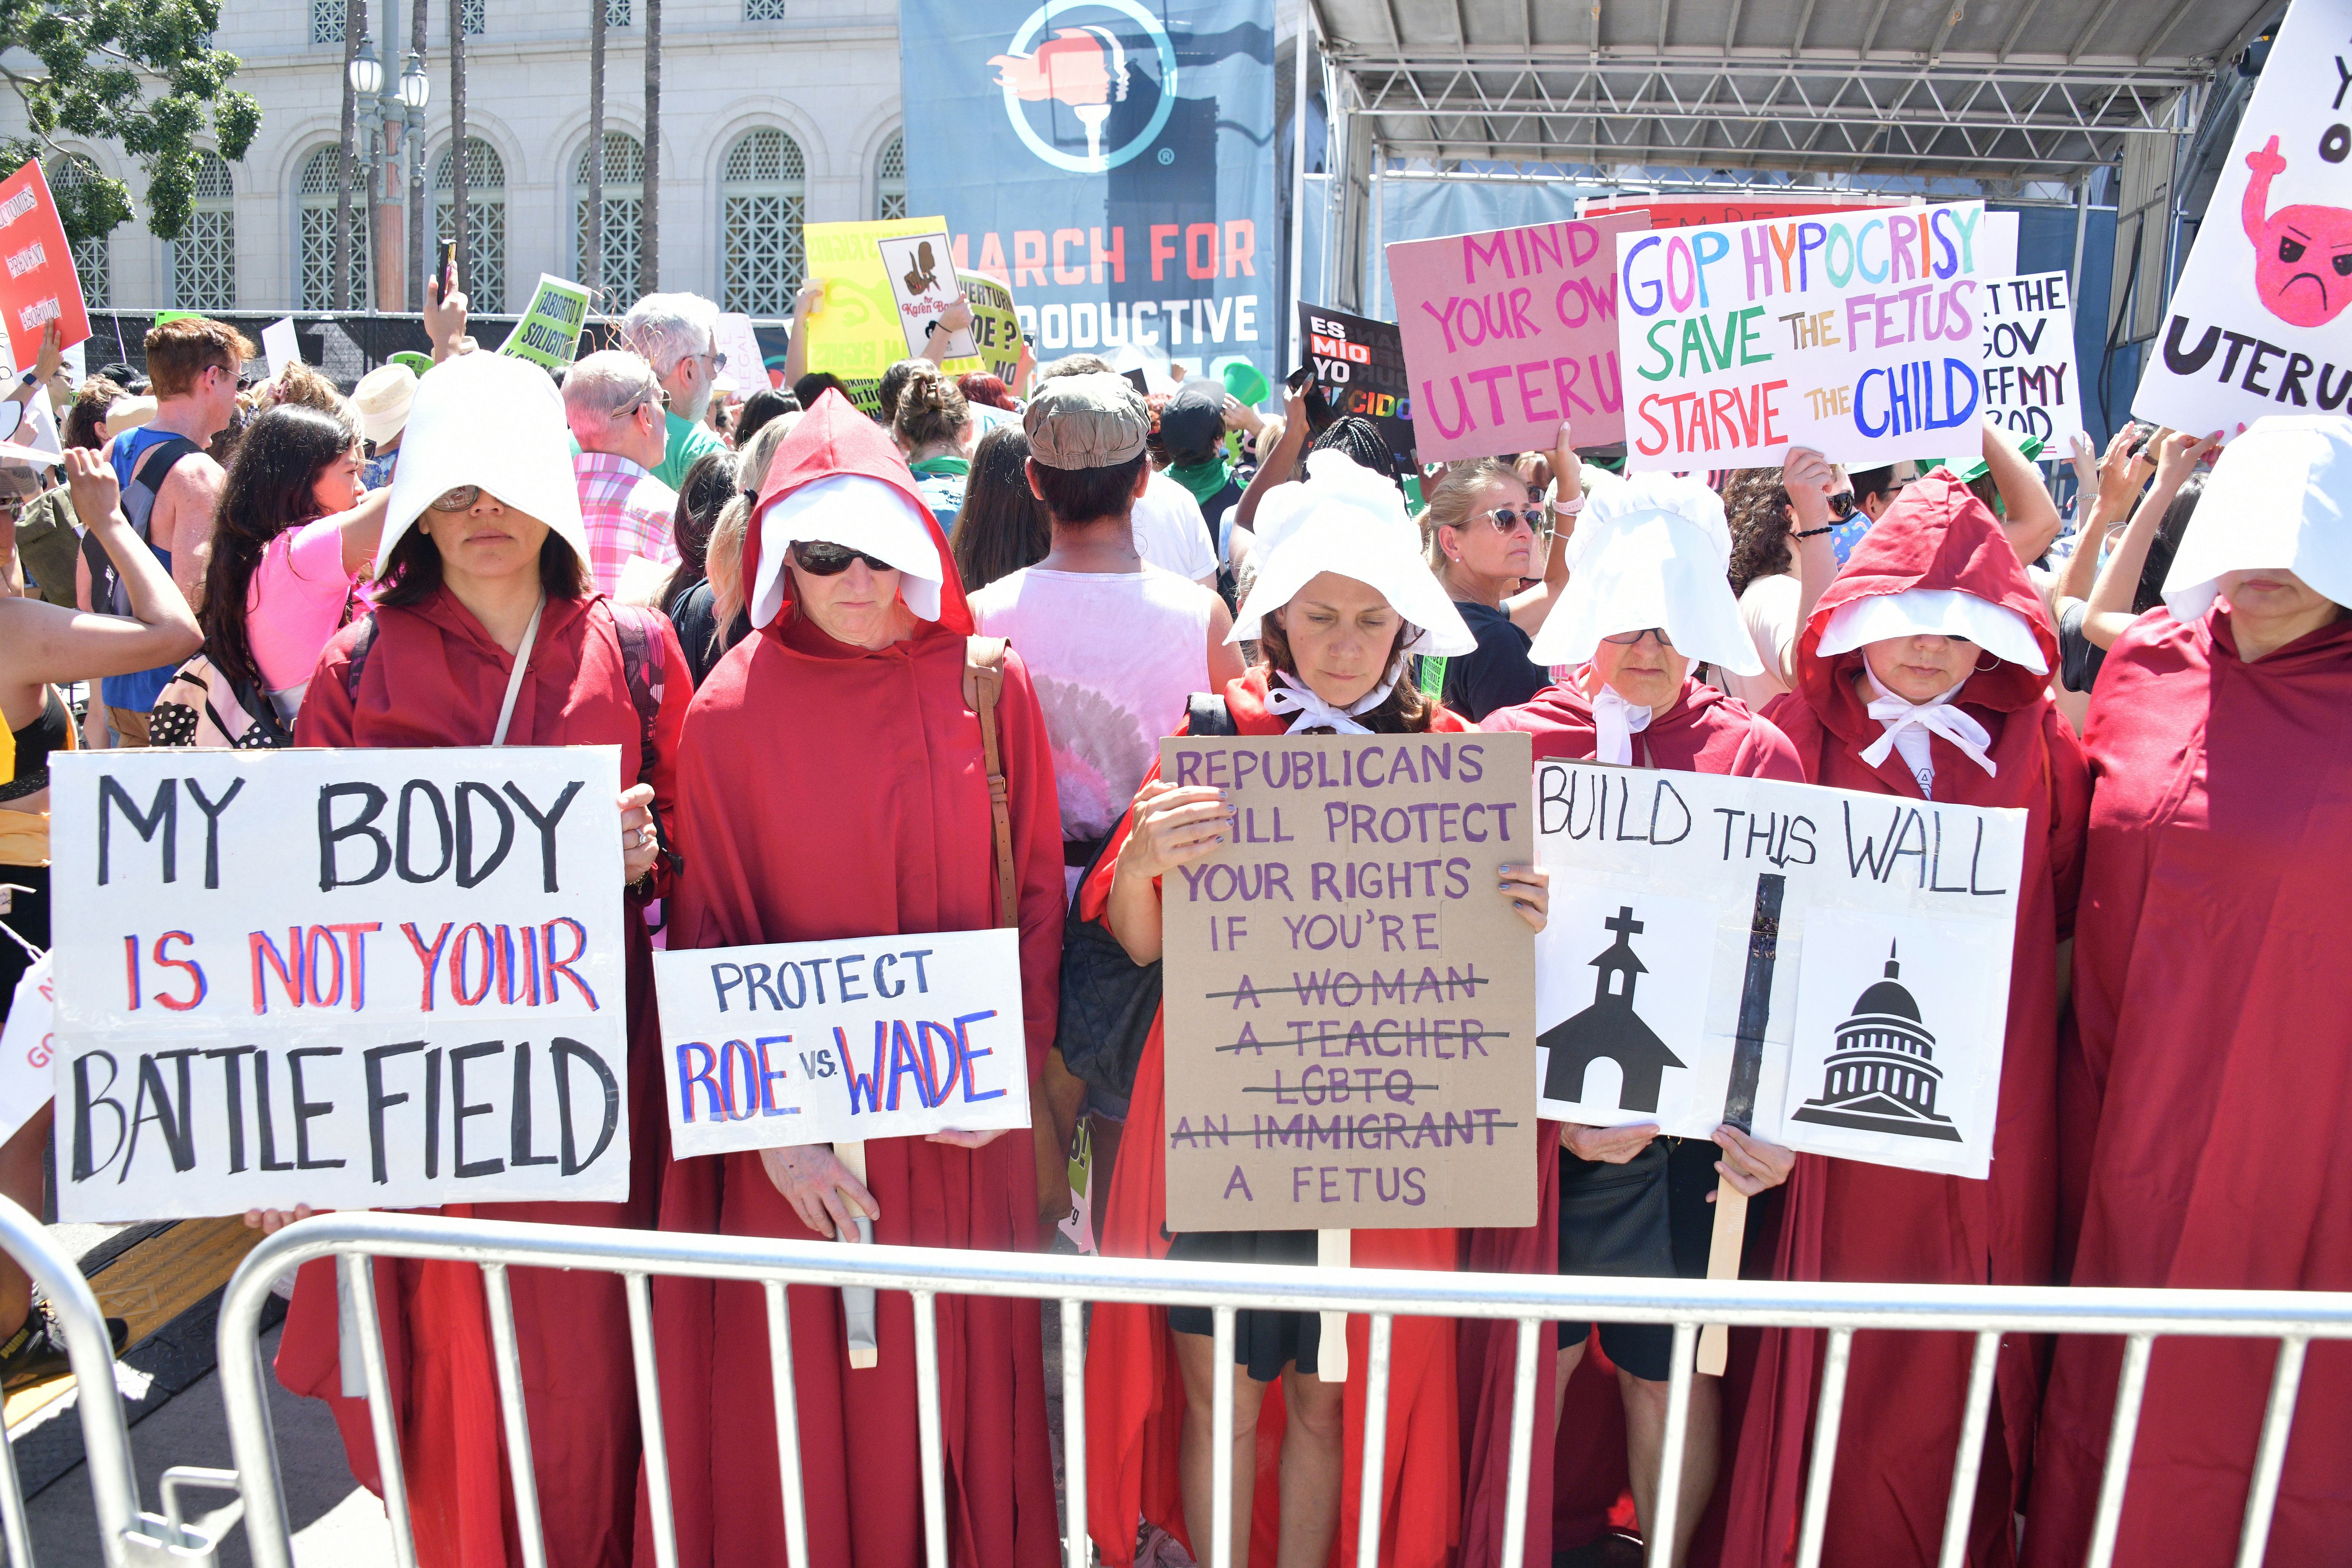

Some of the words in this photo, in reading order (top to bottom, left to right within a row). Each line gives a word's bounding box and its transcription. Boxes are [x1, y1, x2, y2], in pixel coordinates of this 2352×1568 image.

[8, 244, 45, 276] PREVENT
[1150, 219, 1256, 281] FOR
[1463, 222, 1599, 284] MIND
[1623, 231, 1729, 316] GOP
[1741, 207, 1981, 301] HYPOCRISY
[21, 299, 60, 329] ABORTION
[902, 303, 932, 317] Karen
[933, 301, 954, 313] Ba
[959, 280, 1015, 315] VERTURN
[1421, 287, 1542, 354] YOUR
[1556, 273, 1617, 329] OW
[2007, 277, 2066, 311] THE
[971, 315, 997, 348] OE
[1310, 316, 1345, 339] ES
[1313, 336, 1367, 363] MÍO
[1637, 305, 1775, 381] SAVE
[1779, 310, 1841, 351] THE
[1846, 280, 1977, 352] FETUS
[1313, 356, 1350, 383] YO
[1982, 367, 2014, 405] FF
[2017, 362, 2067, 406] MY
[2164, 315, 2352, 416] UTERU
[1319, 385, 1412, 420] CIDO
[1423, 350, 1624, 440] UTERU
[1635, 379, 1788, 456] STARVE
[1804, 385, 1851, 420] THE
[1854, 358, 1979, 438] CHILD
[1176, 743, 1484, 790] REPUBLICANS
[98, 775, 246, 889] MY
[318, 779, 586, 893] BODY
[1197, 806, 1294, 844] ILL
[1324, 801, 1516, 843] PROTECT
[1539, 765, 1691, 845] BUILD
[1713, 808, 1817, 867] THIS
[1843, 800, 2006, 896] WALL
[1178, 861, 1294, 901] YOUR
[1311, 857, 1471, 902] RIGHTS
[1211, 915, 1247, 951] IF
[1283, 909, 1439, 952] YOU'RE
[124, 930, 207, 1010] IS
[249, 922, 383, 1015] NOT
[400, 917, 600, 1012] YOUR
[711, 949, 933, 1012] PROTECT
[1233, 974, 1261, 1010] A
[1293, 963, 1476, 1007] WOMAN
[1234, 1021, 1263, 1056] A
[1287, 1017, 1489, 1060] TEACHER
[676, 1034, 801, 1124] ROE
[833, 1010, 1007, 1116] WADE
[1275, 1064, 1415, 1106] LGBTQ
[1171, 1113, 1229, 1149] AN
[1254, 1108, 1501, 1151] IMMIGRANT
[1223, 1165, 1253, 1201] A
[1293, 1165, 1426, 1206] FETUS
